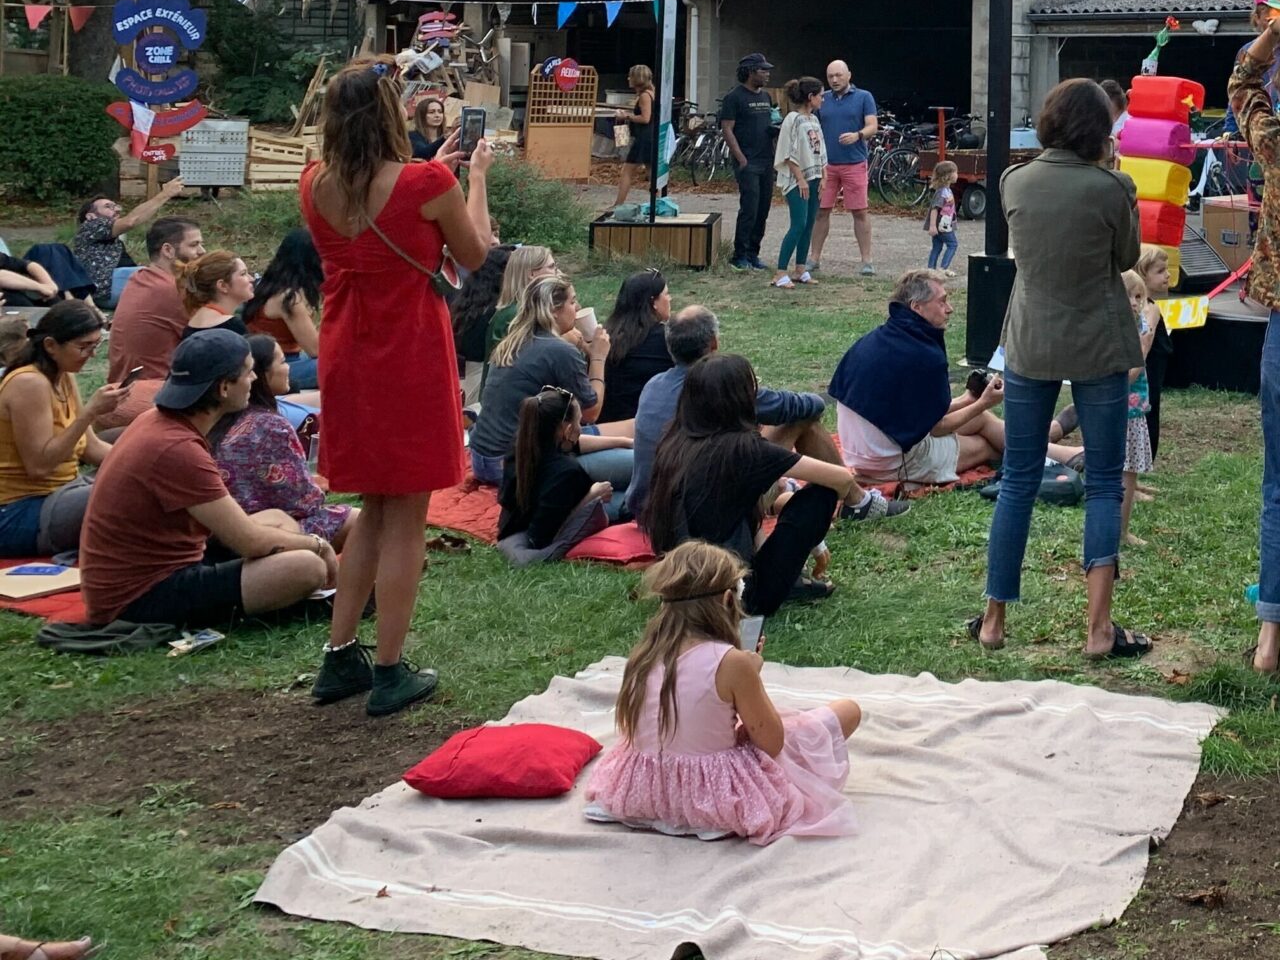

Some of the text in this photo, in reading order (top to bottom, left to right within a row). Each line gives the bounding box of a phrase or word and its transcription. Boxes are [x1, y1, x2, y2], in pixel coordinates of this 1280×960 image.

[116, 7, 200, 41] ESPACE EXTÉRIEUR
[145, 45, 174, 56] ZONE
[148, 55, 172, 64] CHILL
